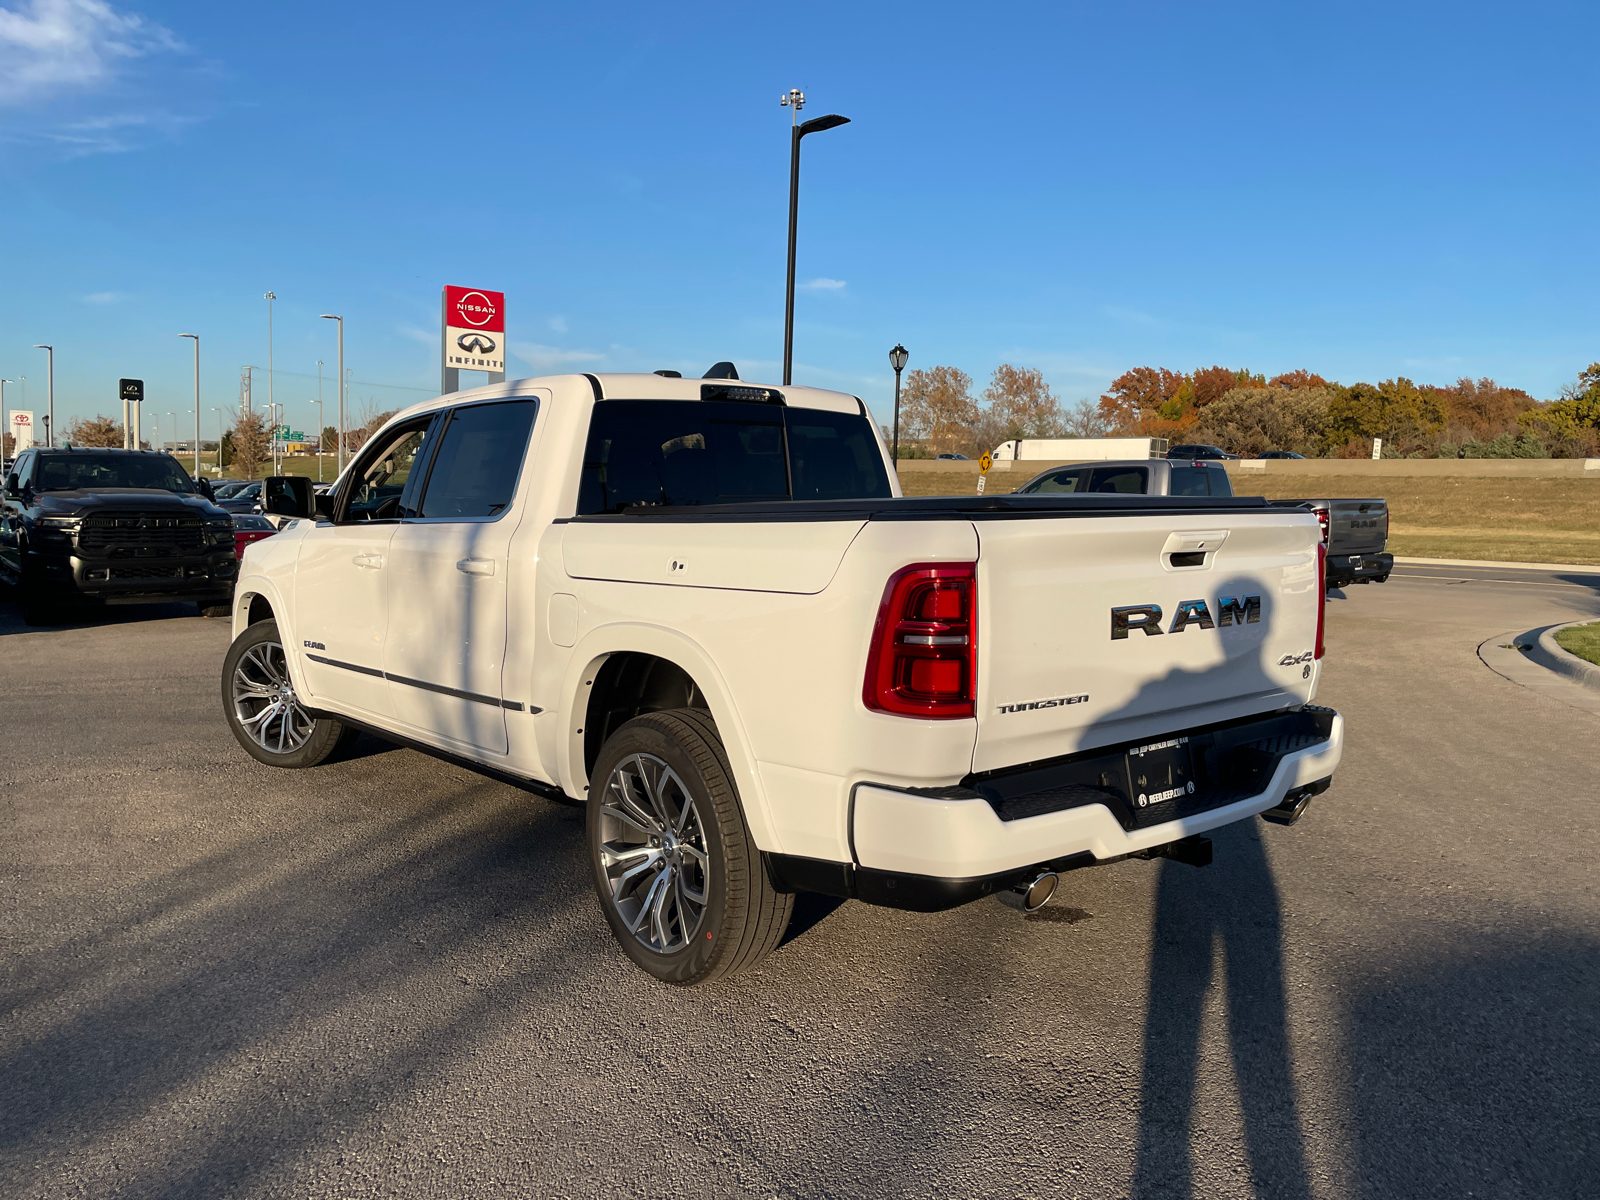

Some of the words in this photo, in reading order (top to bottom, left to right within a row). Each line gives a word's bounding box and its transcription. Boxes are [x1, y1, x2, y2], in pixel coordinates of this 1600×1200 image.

[457, 303, 496, 314] NISSAN
[449, 356, 503, 368] INFINITI
[1350, 520, 1377, 529] RAM
[1111, 593, 1261, 640] RAM
[996, 694, 1089, 714] TUNGSTEN
[1149, 787, 1185, 804] REEDJEEP.COM
